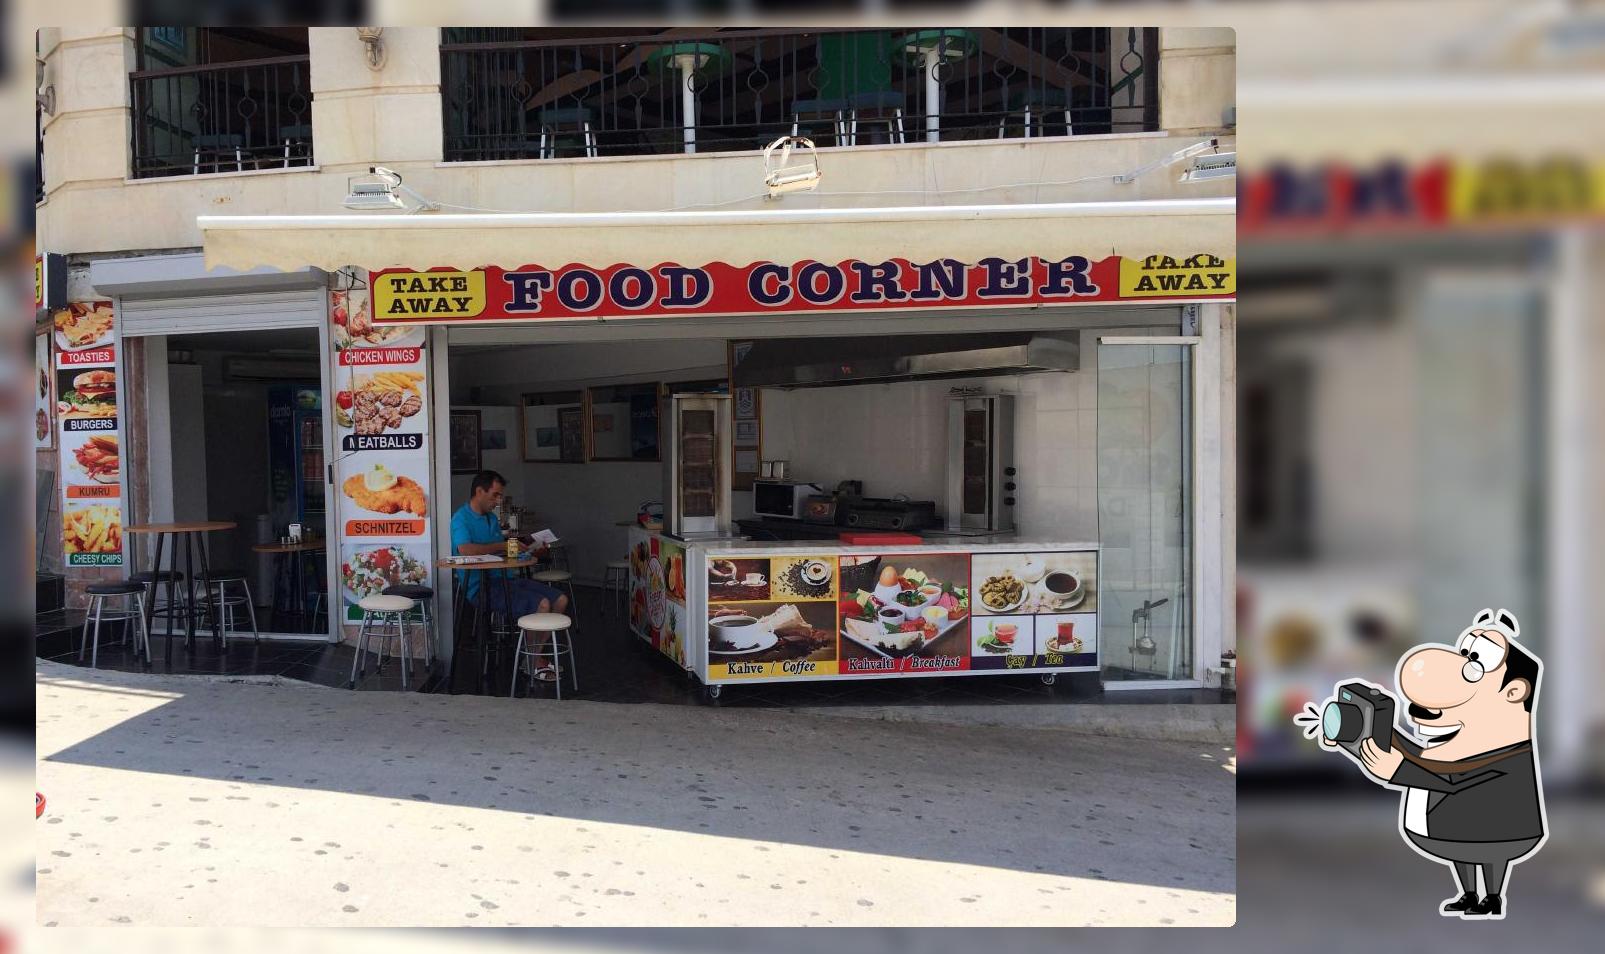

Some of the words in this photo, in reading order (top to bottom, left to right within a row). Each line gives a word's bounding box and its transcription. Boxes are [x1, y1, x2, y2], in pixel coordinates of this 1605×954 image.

[1140, 253, 1224, 270] TAKE
[390, 277, 468, 293] TAKE
[503, 266, 714, 313] FOOD
[748, 256, 1100, 306] CORNER
[1133, 273, 1230, 291] AWAY
[388, 297, 473, 313] AWAY
[68, 352, 110, 363] TOASTIES
[344, 350, 384, 363] CHICKEN
[385, 349, 415, 362] WINGS
[70, 419, 114, 430] BURGERS
[79, 487, 111, 496] KUMRU
[355, 522, 416, 534] SCHNITZEL
[73, 554, 100, 564] CHEESY
[101, 554, 122, 563] CHIPS
[727, 662, 763, 674] Kahve
[783, 661, 816, 674] Coffee
[911, 655, 960, 670] Breakfast
